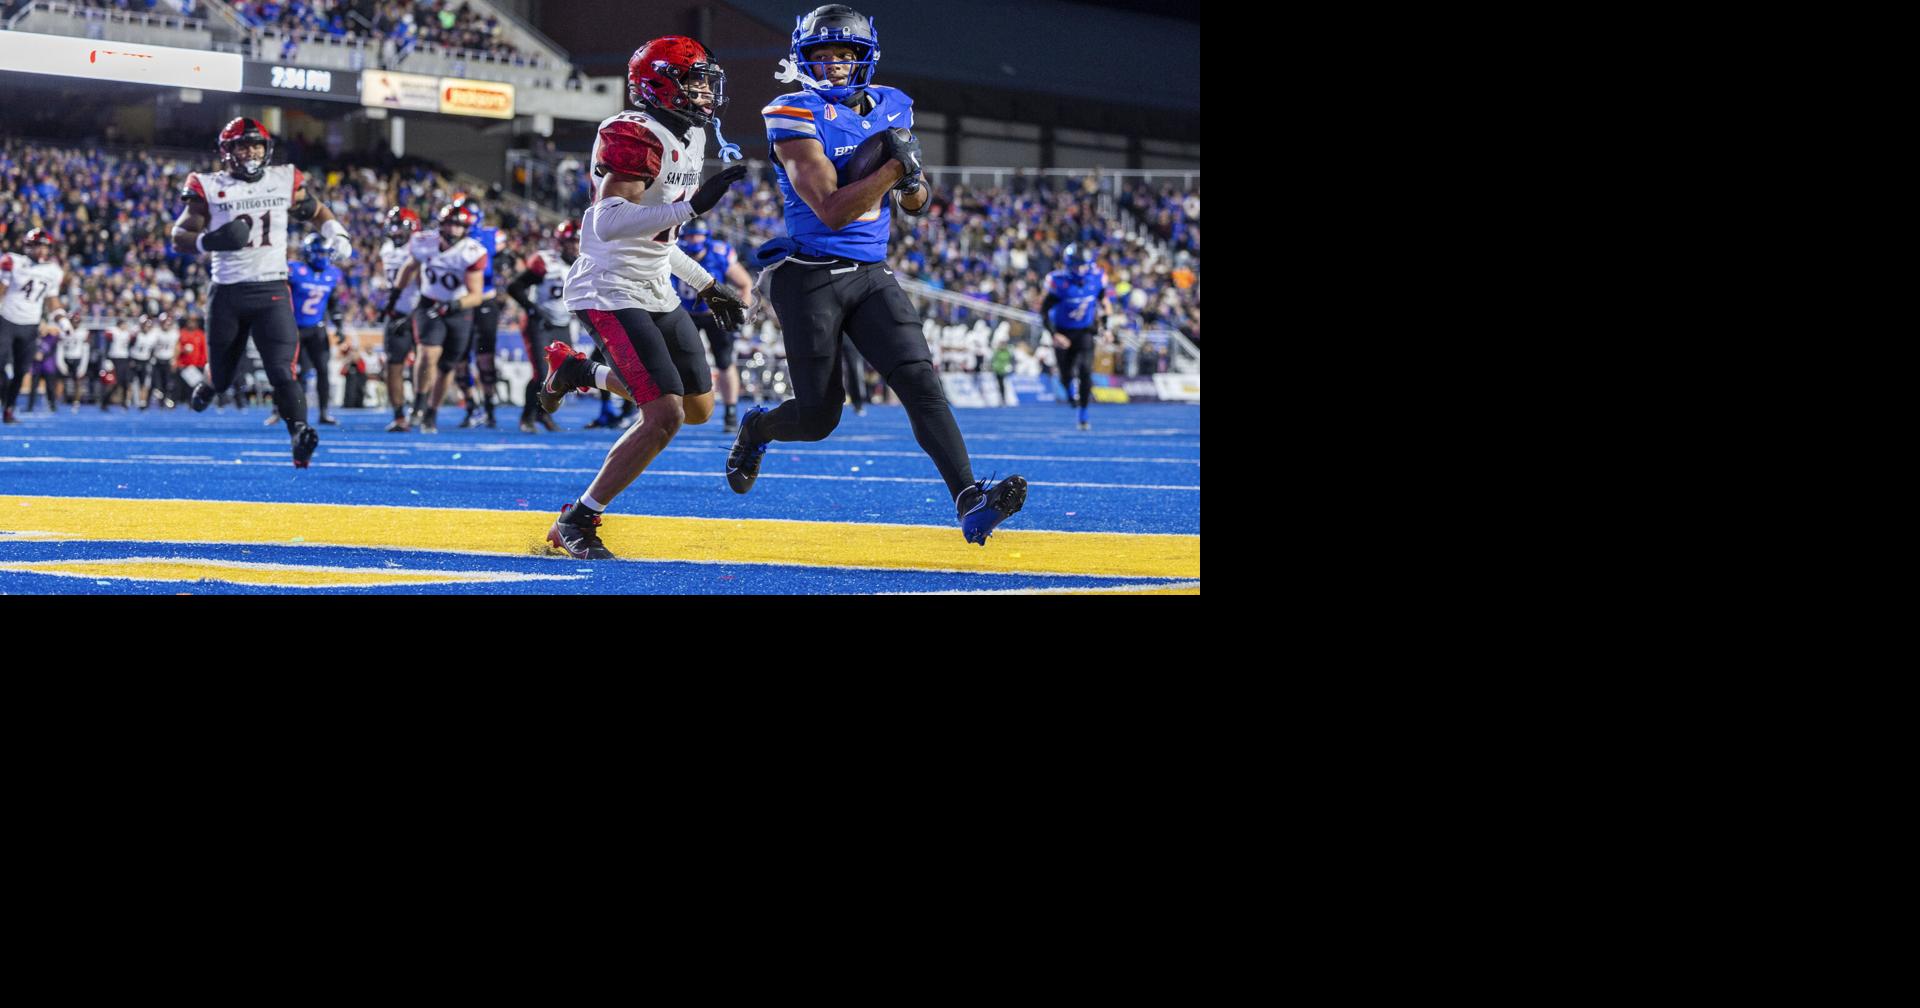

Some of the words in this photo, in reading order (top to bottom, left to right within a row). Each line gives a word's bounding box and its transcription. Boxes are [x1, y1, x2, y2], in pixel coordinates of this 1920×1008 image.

[664, 172, 682, 185] SAN
[236, 201, 261, 211] DIEGO
[20, 279, 47, 302] 47
